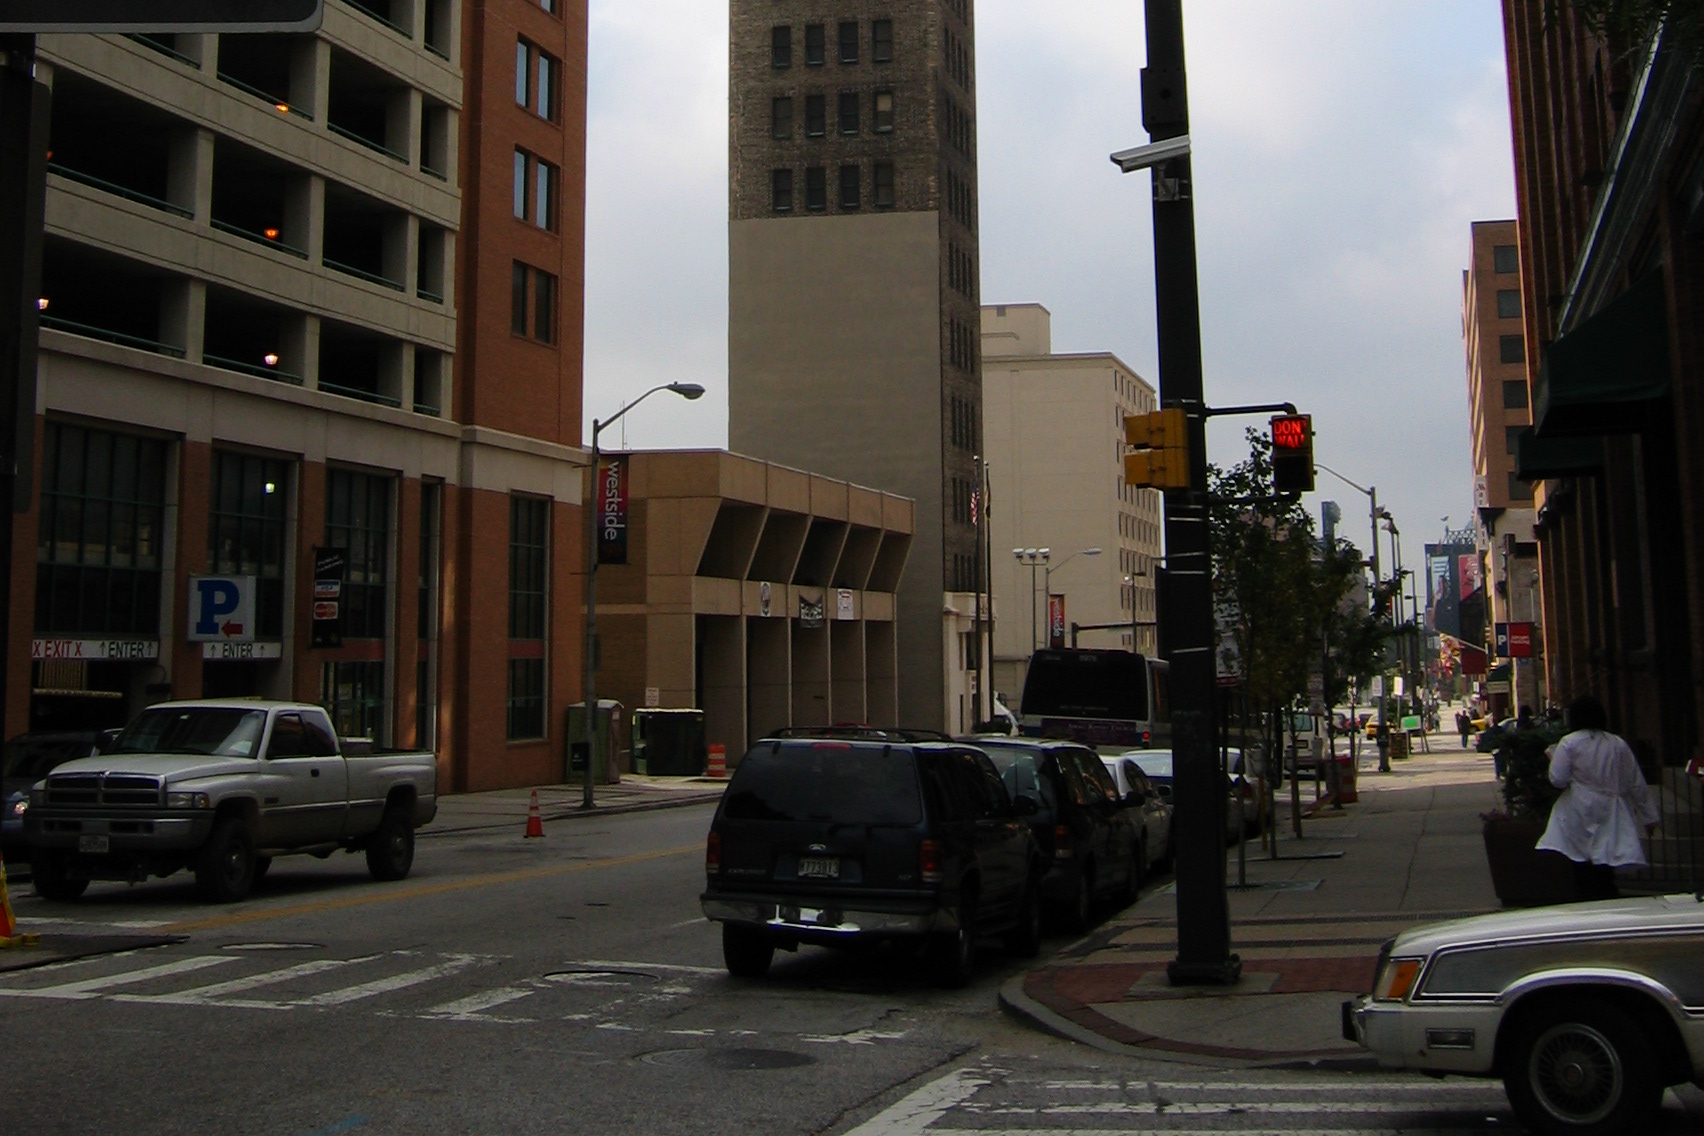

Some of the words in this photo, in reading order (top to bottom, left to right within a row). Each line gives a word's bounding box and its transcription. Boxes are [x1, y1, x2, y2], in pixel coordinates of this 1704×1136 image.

[605, 461, 625, 540] westside
[196, 579, 240, 634] P
[45, 640, 72, 658] EXIT
[108, 640, 145, 658] ENTER
[1497, 634, 1507, 646] P
[222, 642, 253, 658] ENTER
